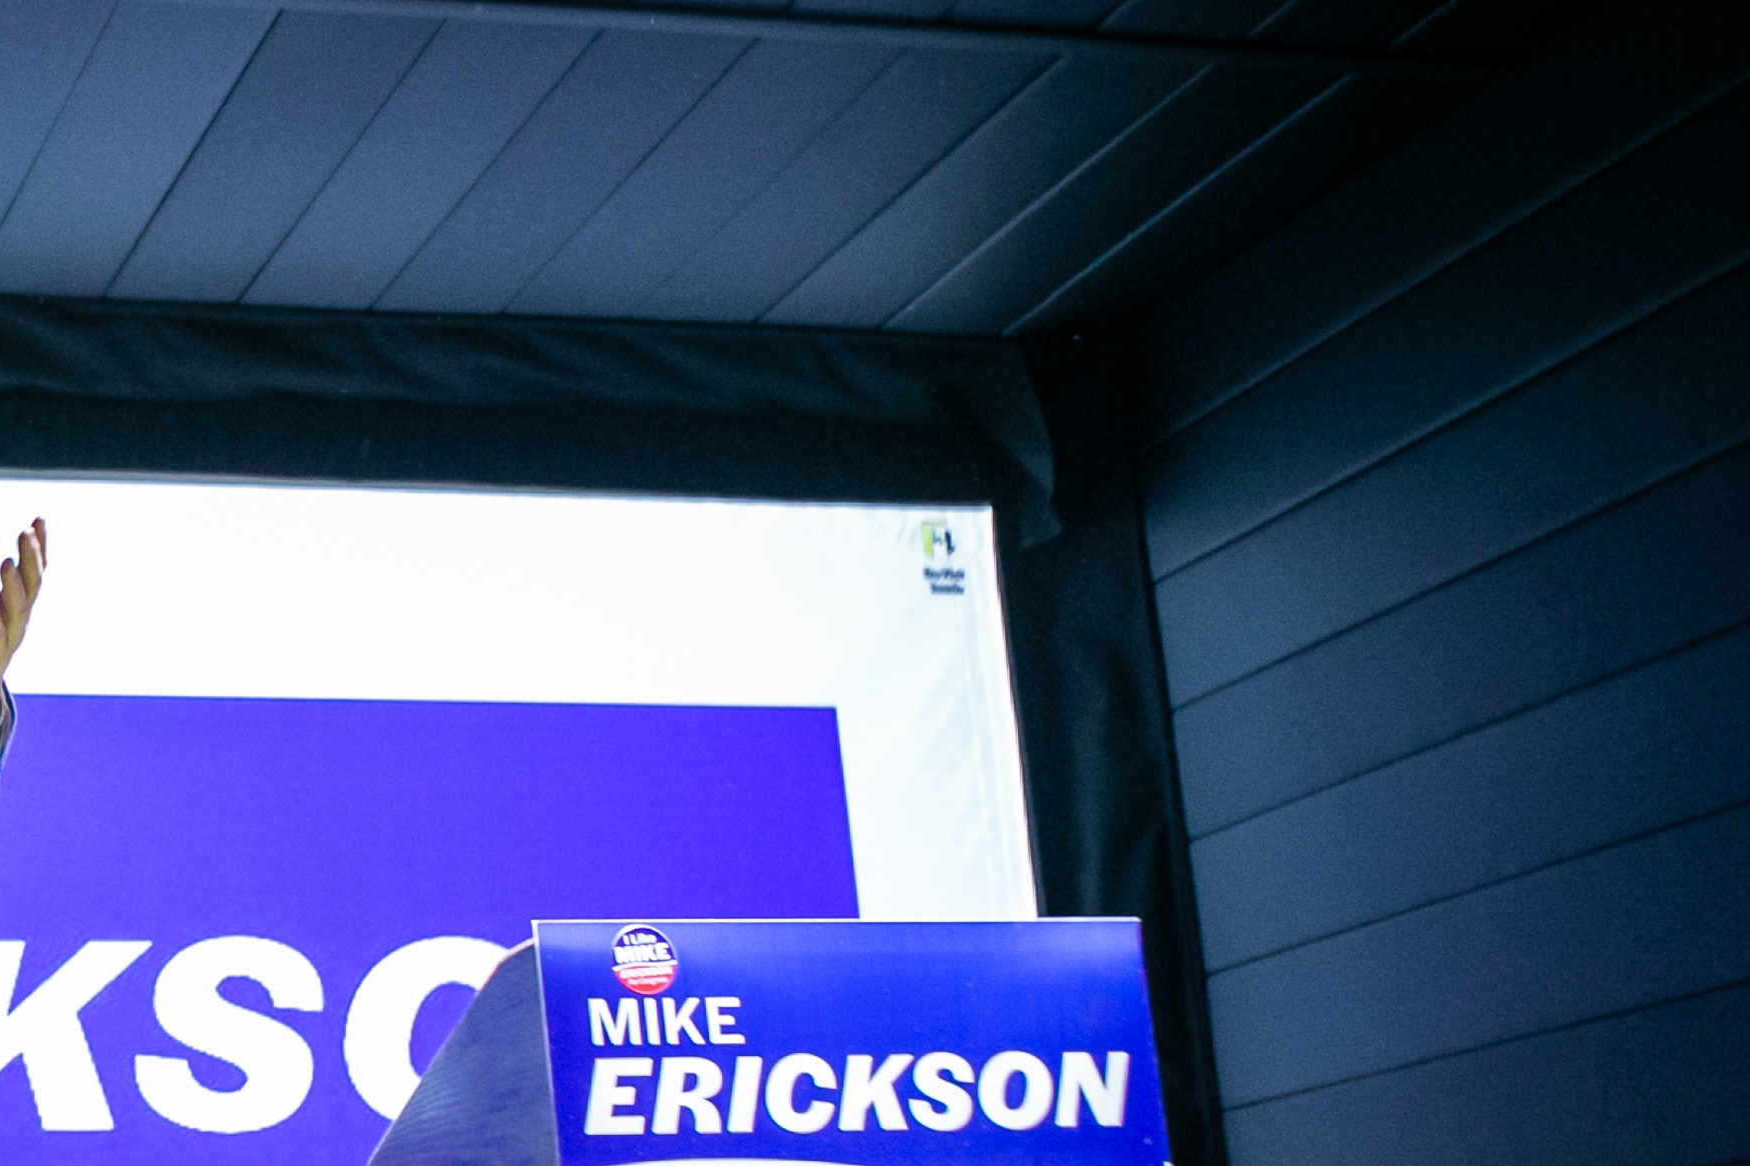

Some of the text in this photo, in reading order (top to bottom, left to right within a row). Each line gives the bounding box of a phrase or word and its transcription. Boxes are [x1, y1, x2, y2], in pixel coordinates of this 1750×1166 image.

[613, 942, 671, 964] MIKE
[587, 996, 746, 1046] MIKE
[584, 1050, 1129, 1136] ERICKSON
